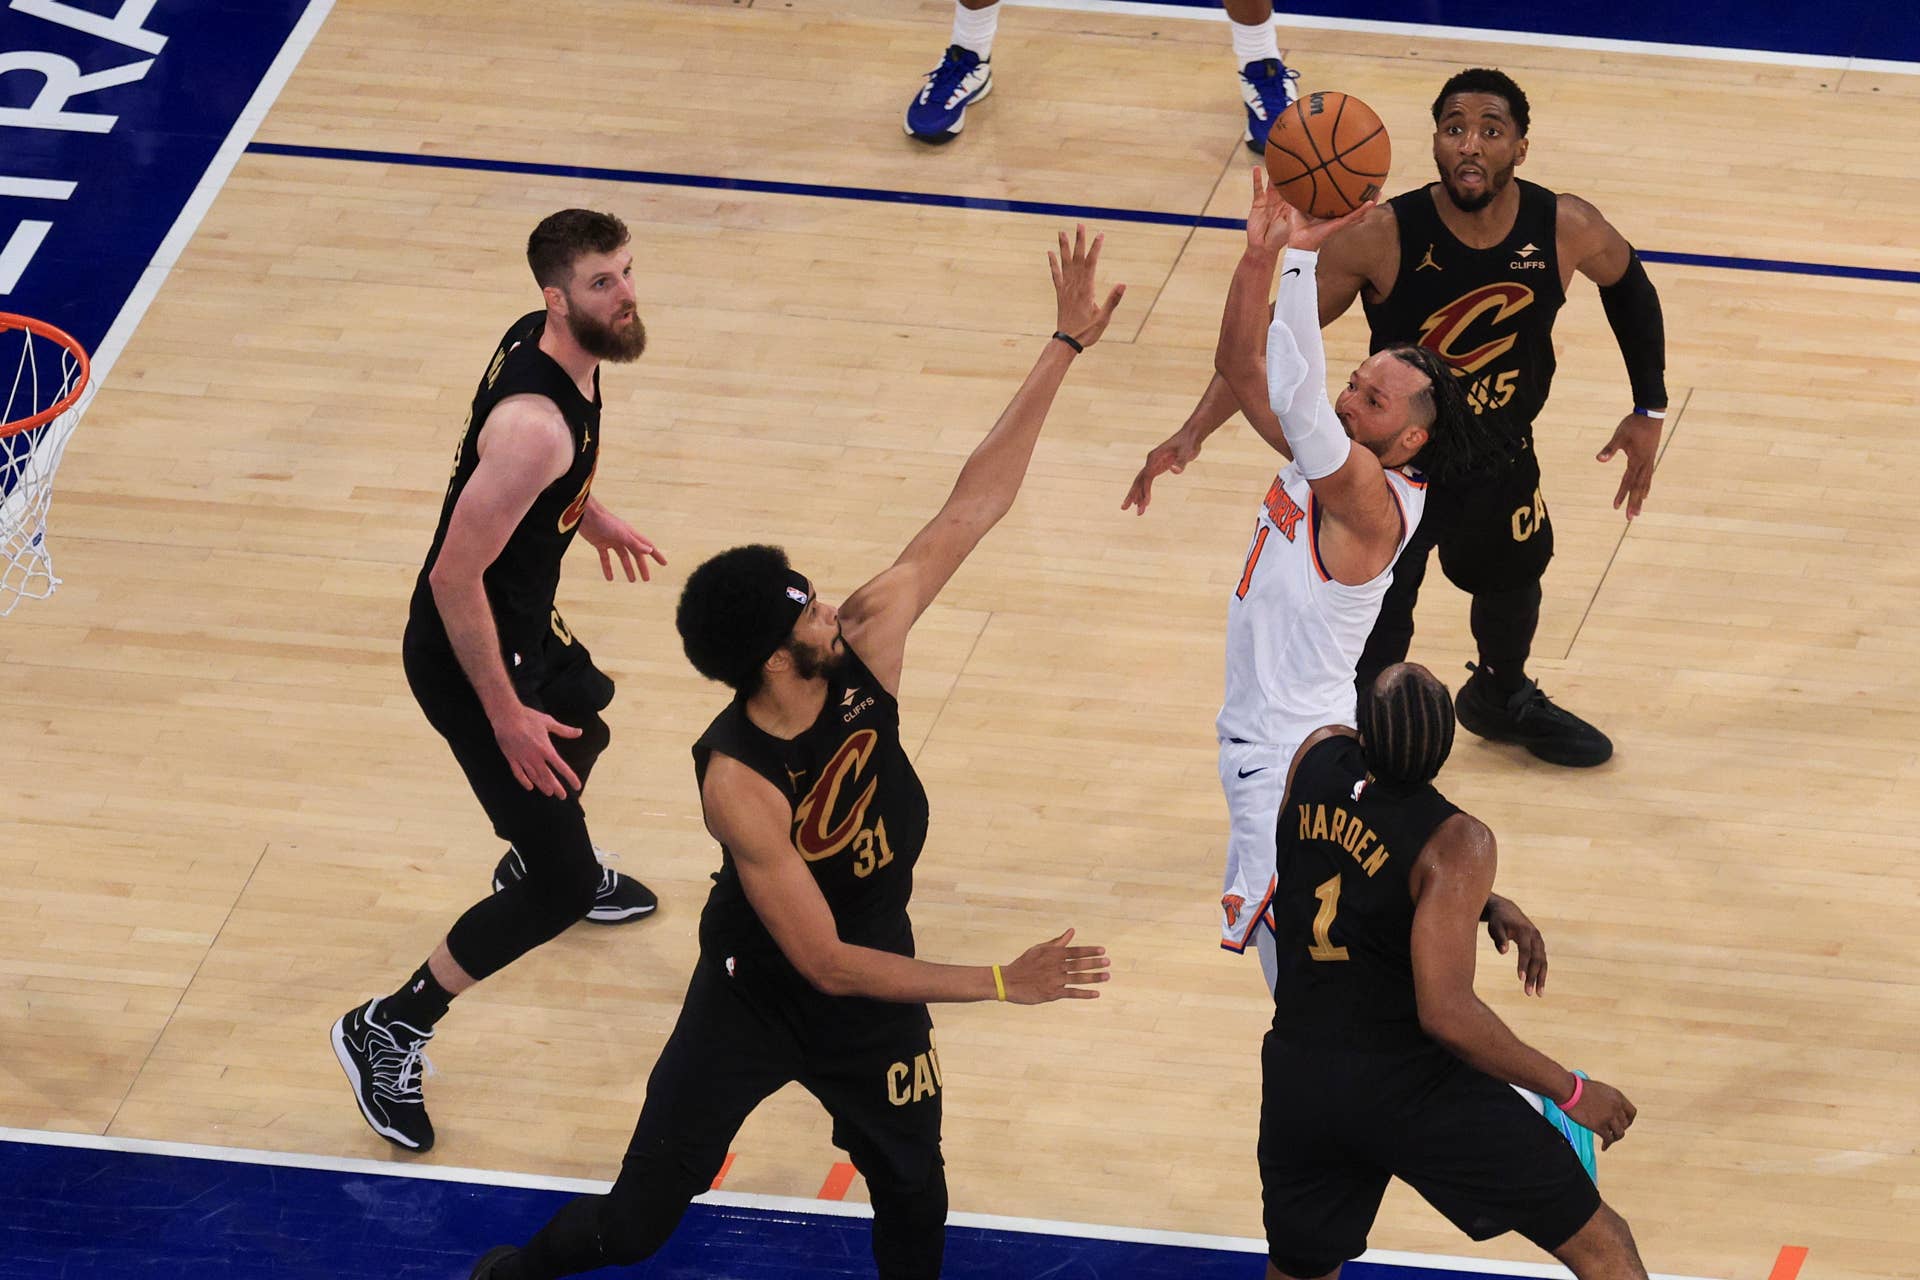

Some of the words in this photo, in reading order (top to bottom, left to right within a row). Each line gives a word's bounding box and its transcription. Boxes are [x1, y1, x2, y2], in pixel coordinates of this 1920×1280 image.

[1510, 261, 1546, 270] CLIFFS
[843, 696, 875, 723] CLIFFS
[852, 815, 894, 879] 31
[1298, 803, 1390, 878] HARDEN
[1307, 872, 1350, 962] 1
